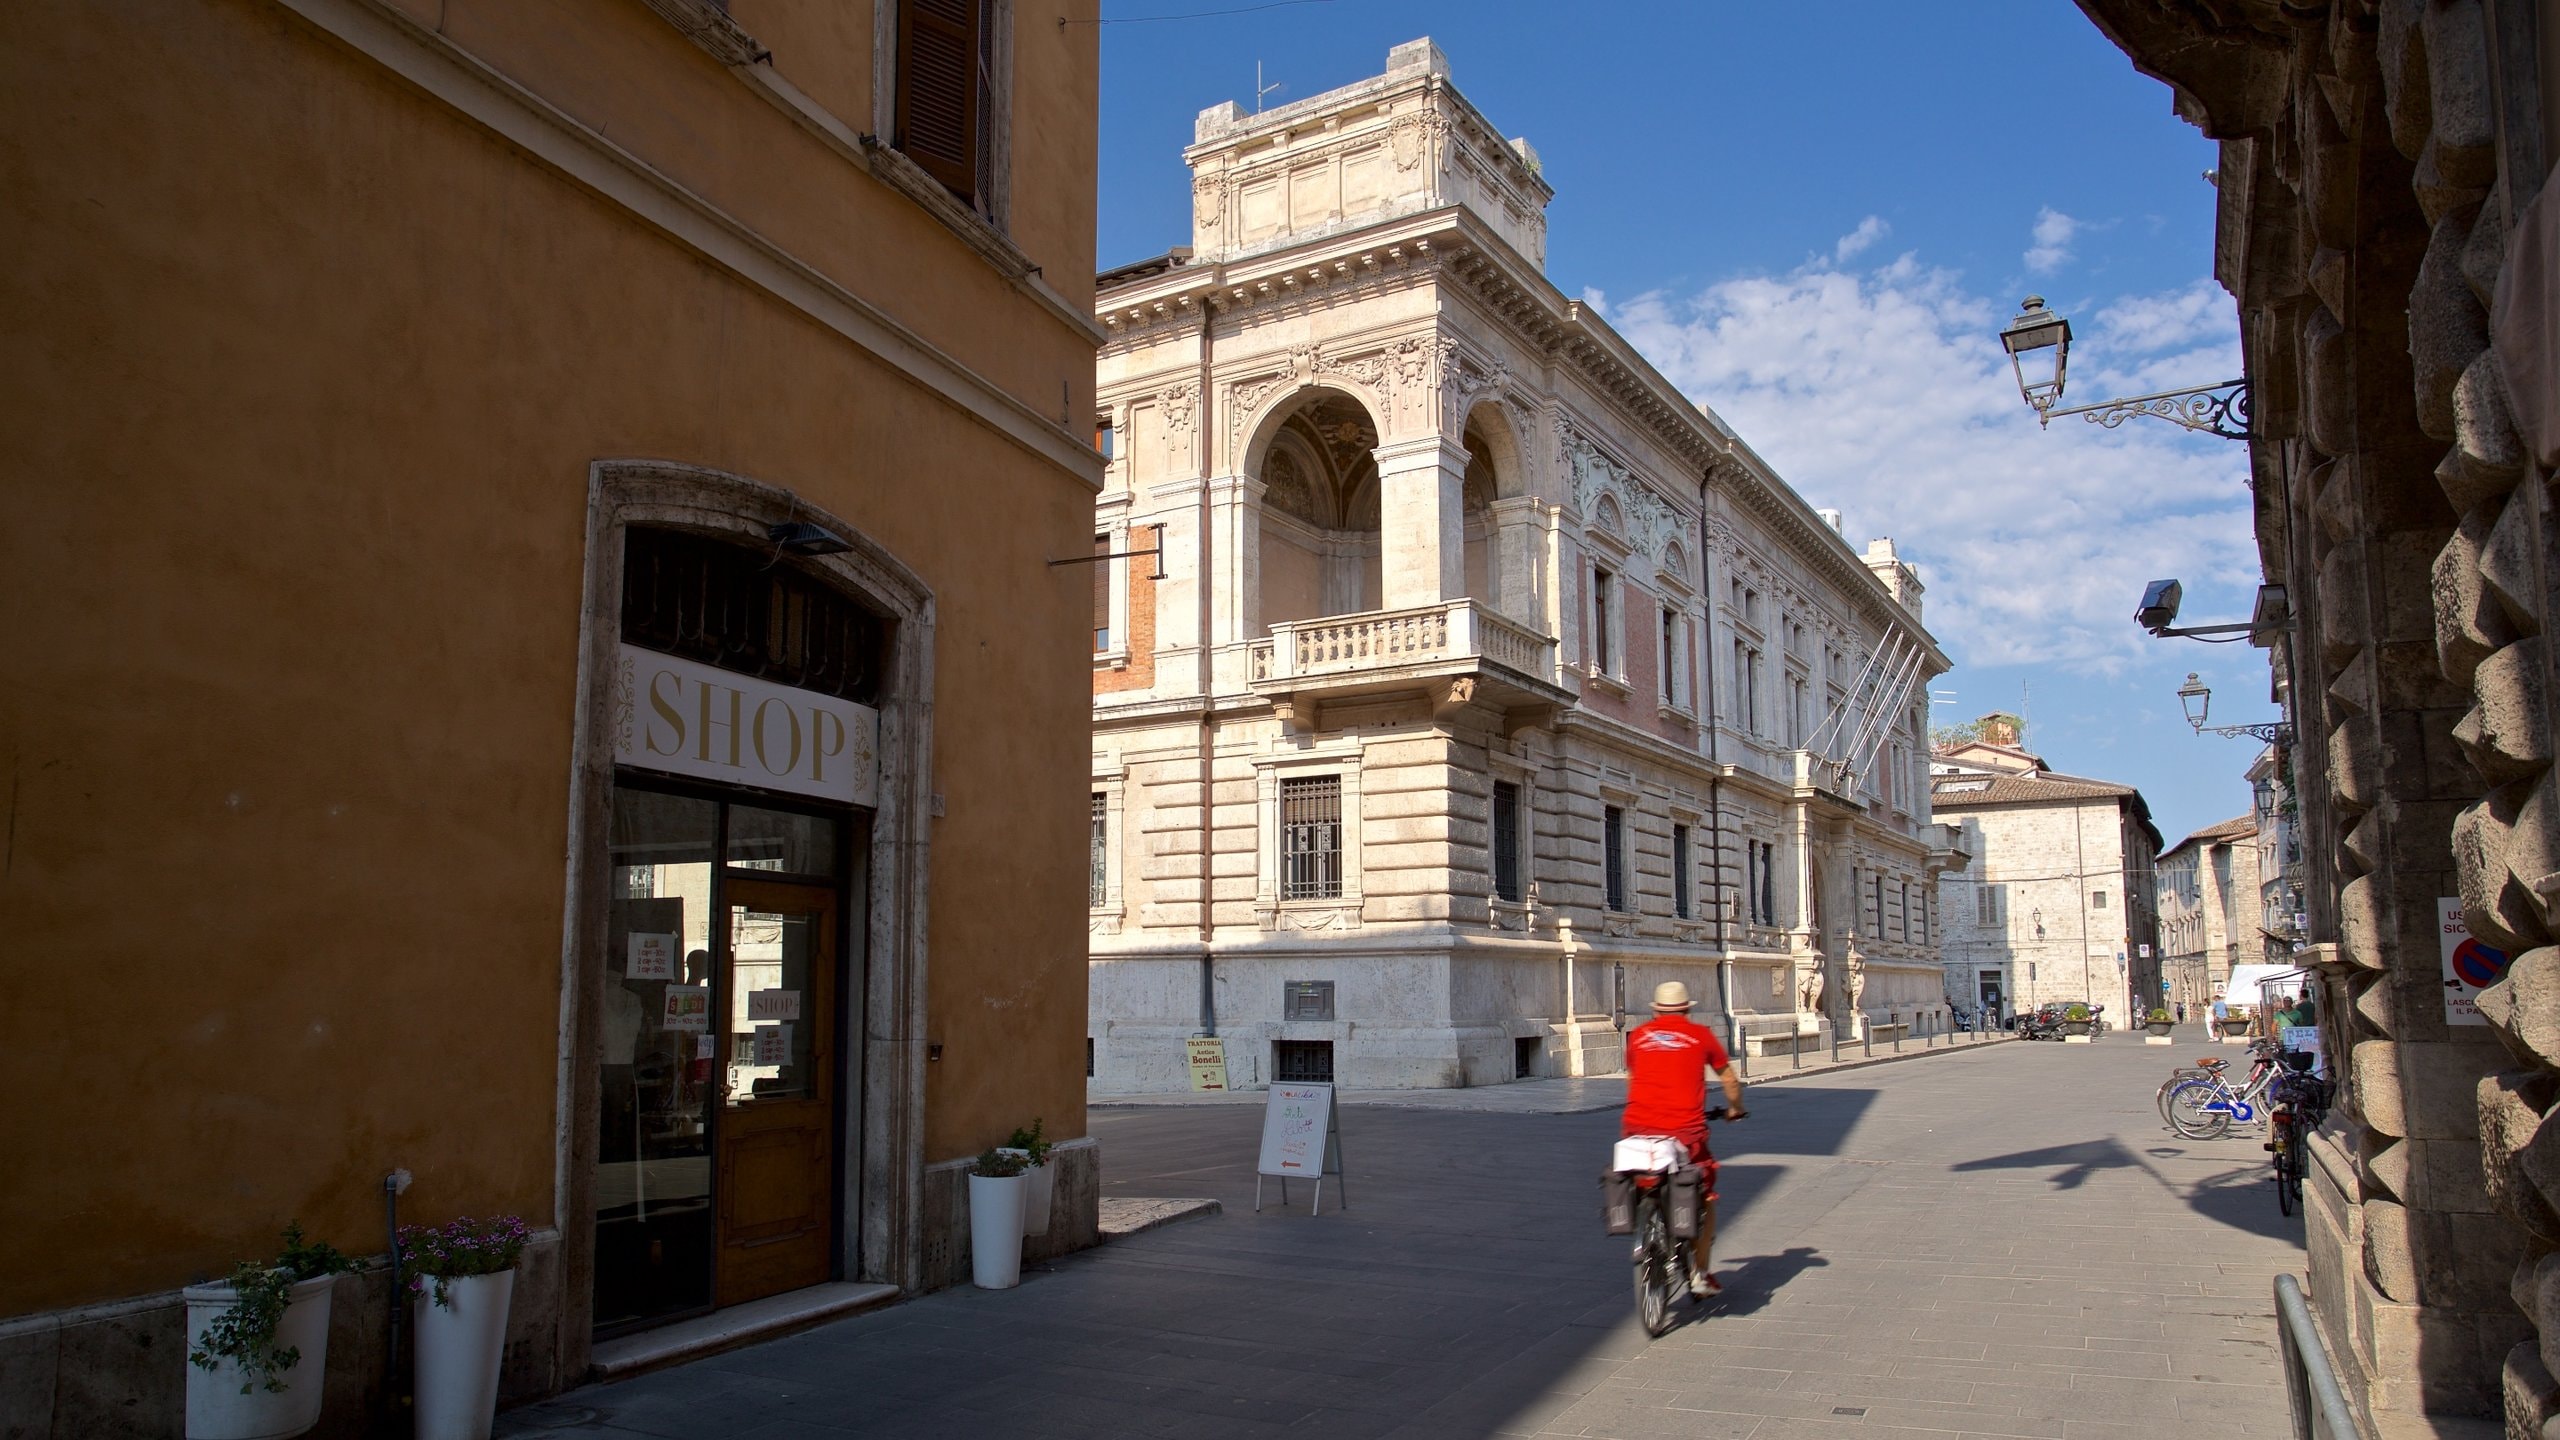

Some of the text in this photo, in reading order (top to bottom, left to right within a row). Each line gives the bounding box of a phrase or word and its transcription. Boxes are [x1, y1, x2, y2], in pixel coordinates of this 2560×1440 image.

[646, 669, 845, 784] SHOP
[2443, 924, 2466, 933] SIC
[756, 997, 793, 1014] SHOP
[1192, 1055, 1221, 1064] Bonelli
